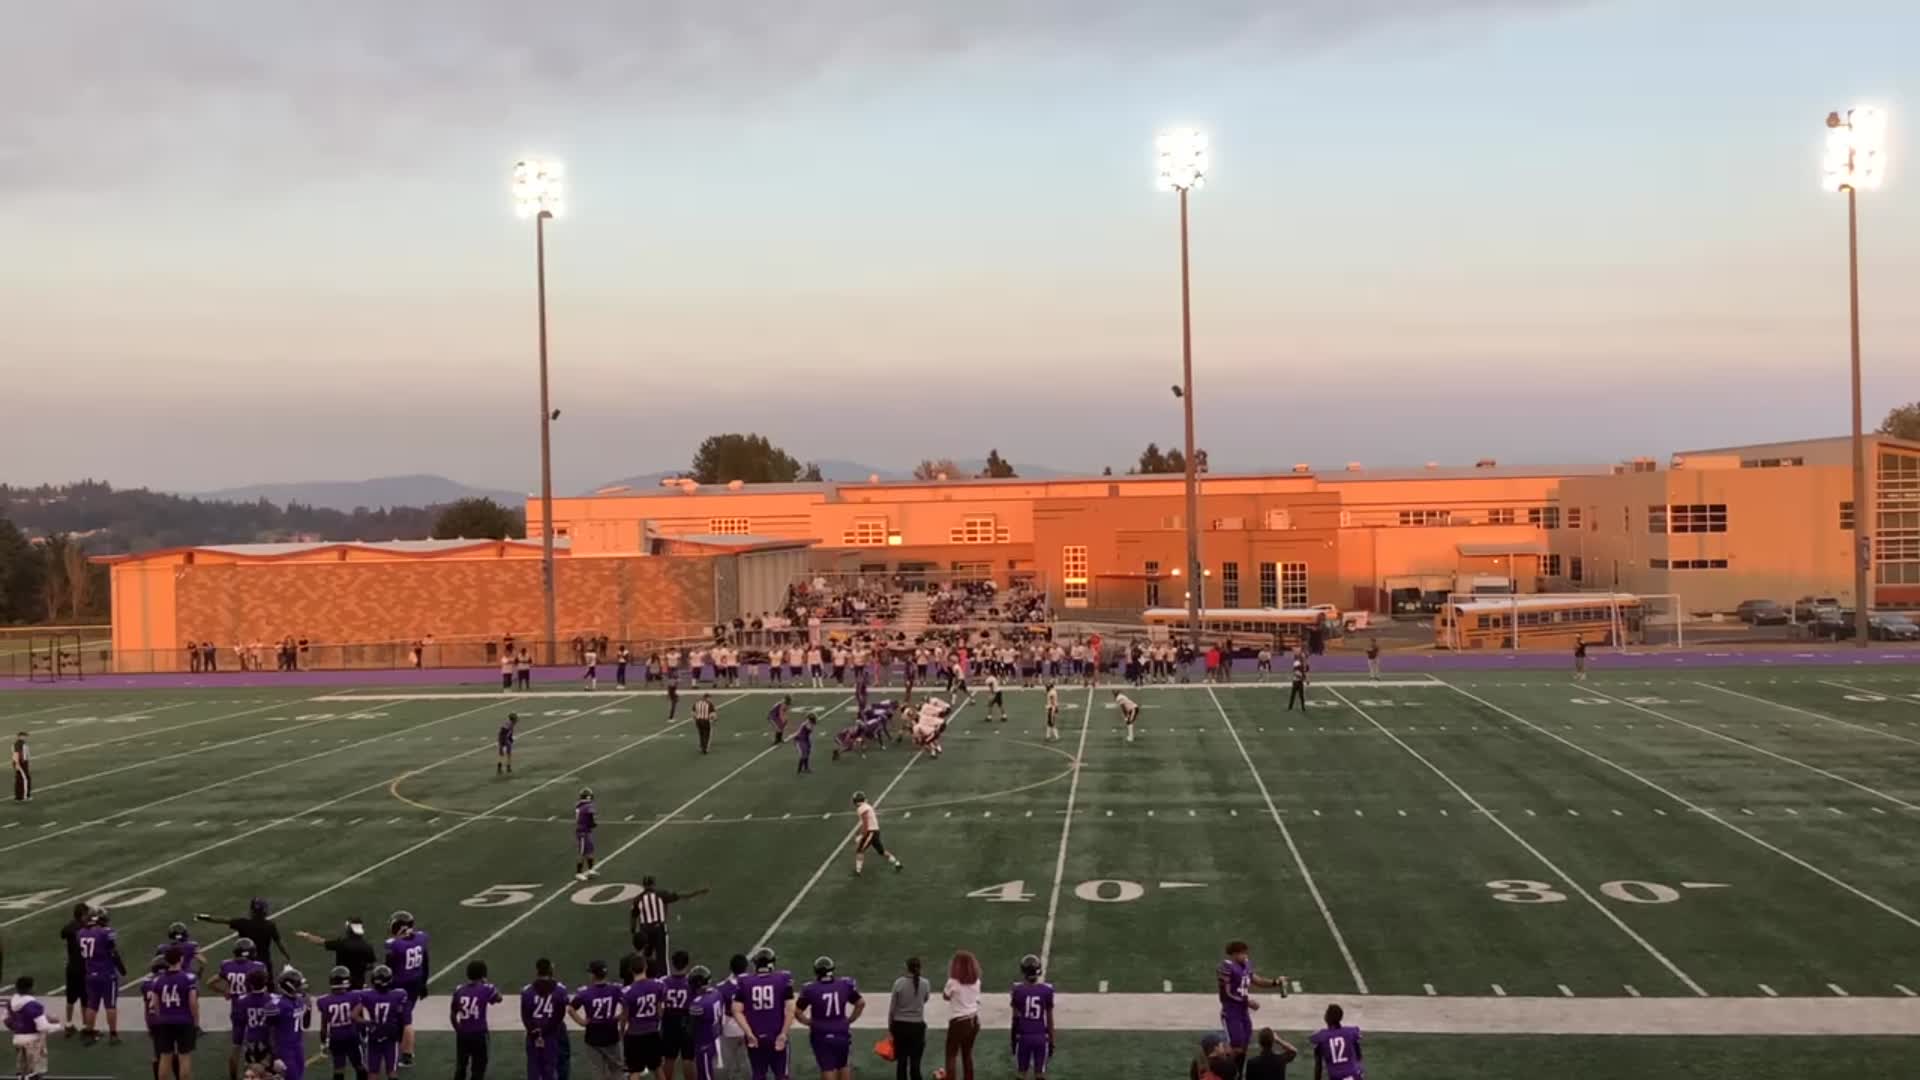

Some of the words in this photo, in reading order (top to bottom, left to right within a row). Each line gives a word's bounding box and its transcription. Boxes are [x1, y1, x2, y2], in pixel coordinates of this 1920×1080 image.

[80, 937, 95, 960] 57
[405, 946, 423, 970] 66
[228, 972, 246, 994] 28
[161, 984, 181, 1008] 44
[459, 996, 480, 1020] 34
[532, 993, 554, 1019] 24
[592, 996, 613, 1019] 27
[636, 993, 656, 1018] 23
[752, 985, 775, 1010] 99
[822, 991, 841, 1017] 71
[1025, 995, 1041, 1019] 15
[328, 1002, 352, 1028] 20
[374, 1002, 391, 1025] 17
[1329, 1036, 1348, 1064] 12
